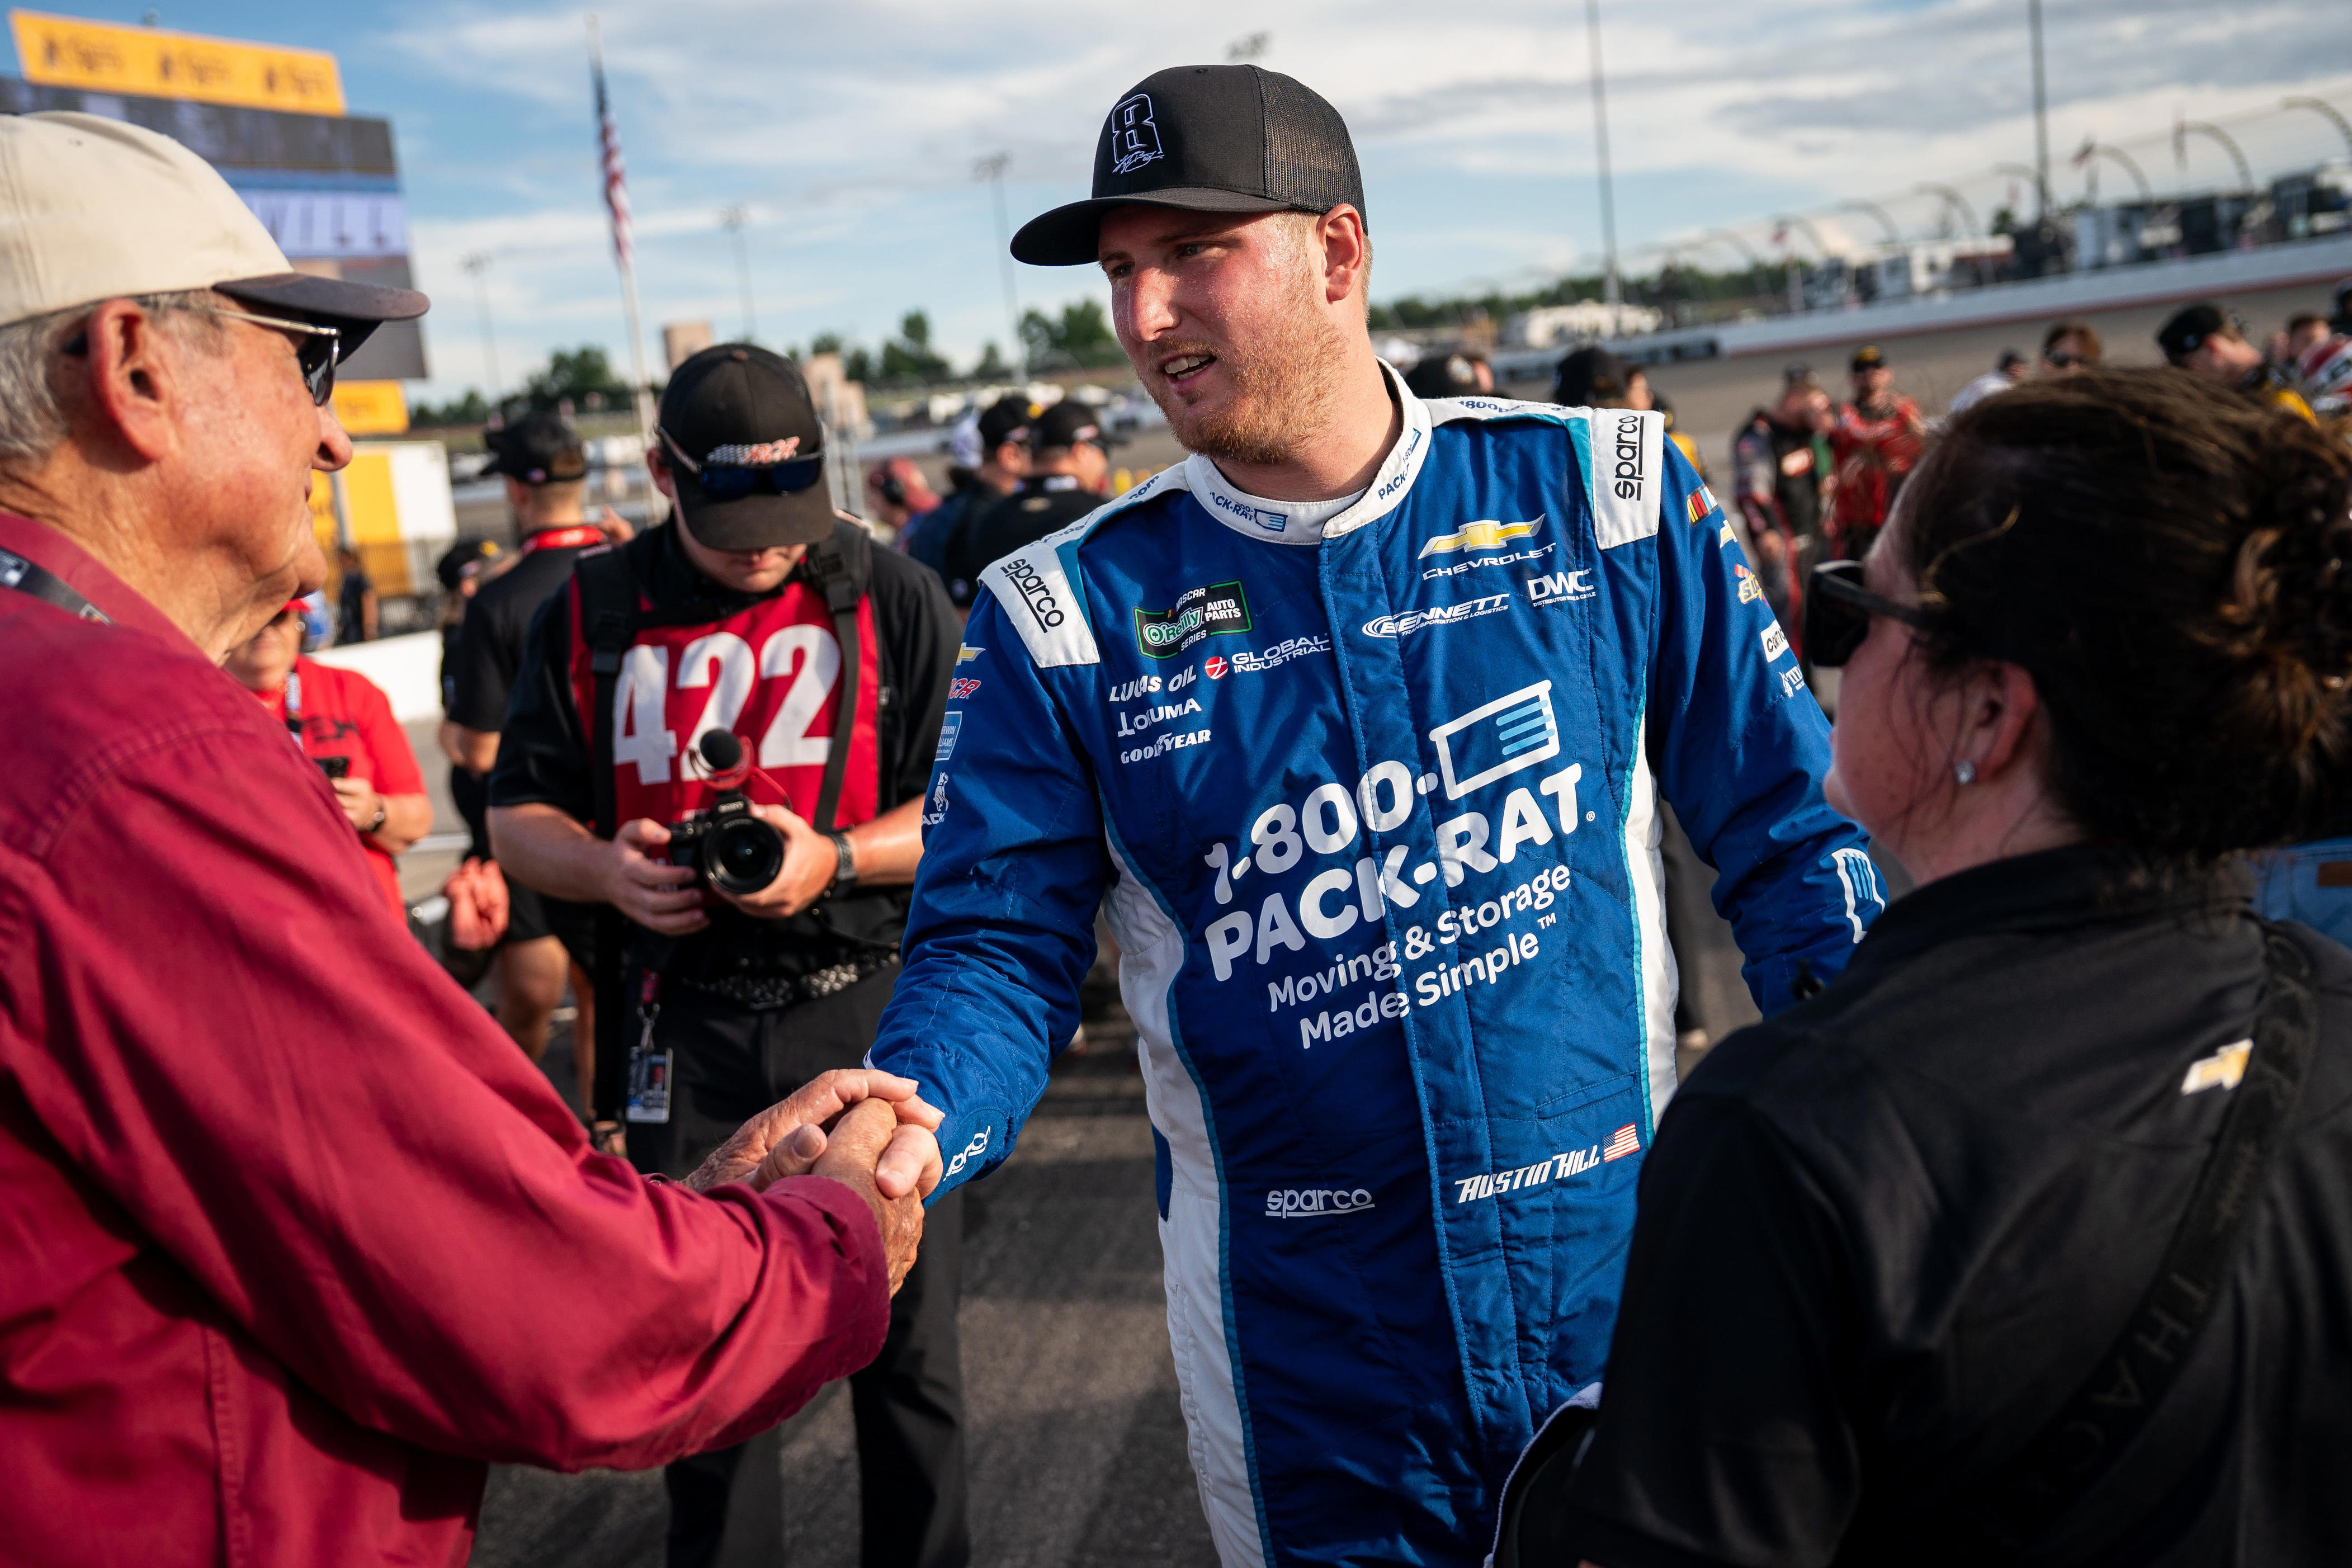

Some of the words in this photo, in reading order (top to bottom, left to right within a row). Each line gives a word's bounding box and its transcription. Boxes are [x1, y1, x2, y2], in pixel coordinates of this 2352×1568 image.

[1112, 93, 1164, 164] 8
[1614, 415, 1645, 501] sparco
[1422, 542, 1556, 580] CHEVROLET
[1000, 559, 1065, 634] sparco
[1176, 588, 1206, 612] NASCAR
[1527, 569, 1594, 601] DWC
[1205, 608, 1241, 622] PARTS
[1207, 598, 1236, 612] AUTO
[1380, 593, 1510, 634] BENNETT
[1533, 596, 1567, 607] DISTRIBUTOR
[1146, 608, 1202, 644] O'Reilly
[1401, 616, 1463, 636] TRANSPORTATION
[1470, 605, 1509, 617] LOGISTICS
[1180, 630, 1207, 651] SERIES
[1231, 635, 1330, 664] GLOBAL
[1234, 645, 1331, 673] INDUSTRIAL
[1168, 665, 1198, 692] OIL
[612, 624, 840, 786] 422
[1268, 938, 1400, 1012] Moving
[1404, 925, 1435, 960] &
[1438, 863, 1571, 946] Storage
[1299, 991, 1411, 1049] Made
[1454, 1160, 1553, 1203] AUSTIN
[1552, 1144, 1600, 1179] HILL
[1265, 1188, 1375, 1219] sparco
